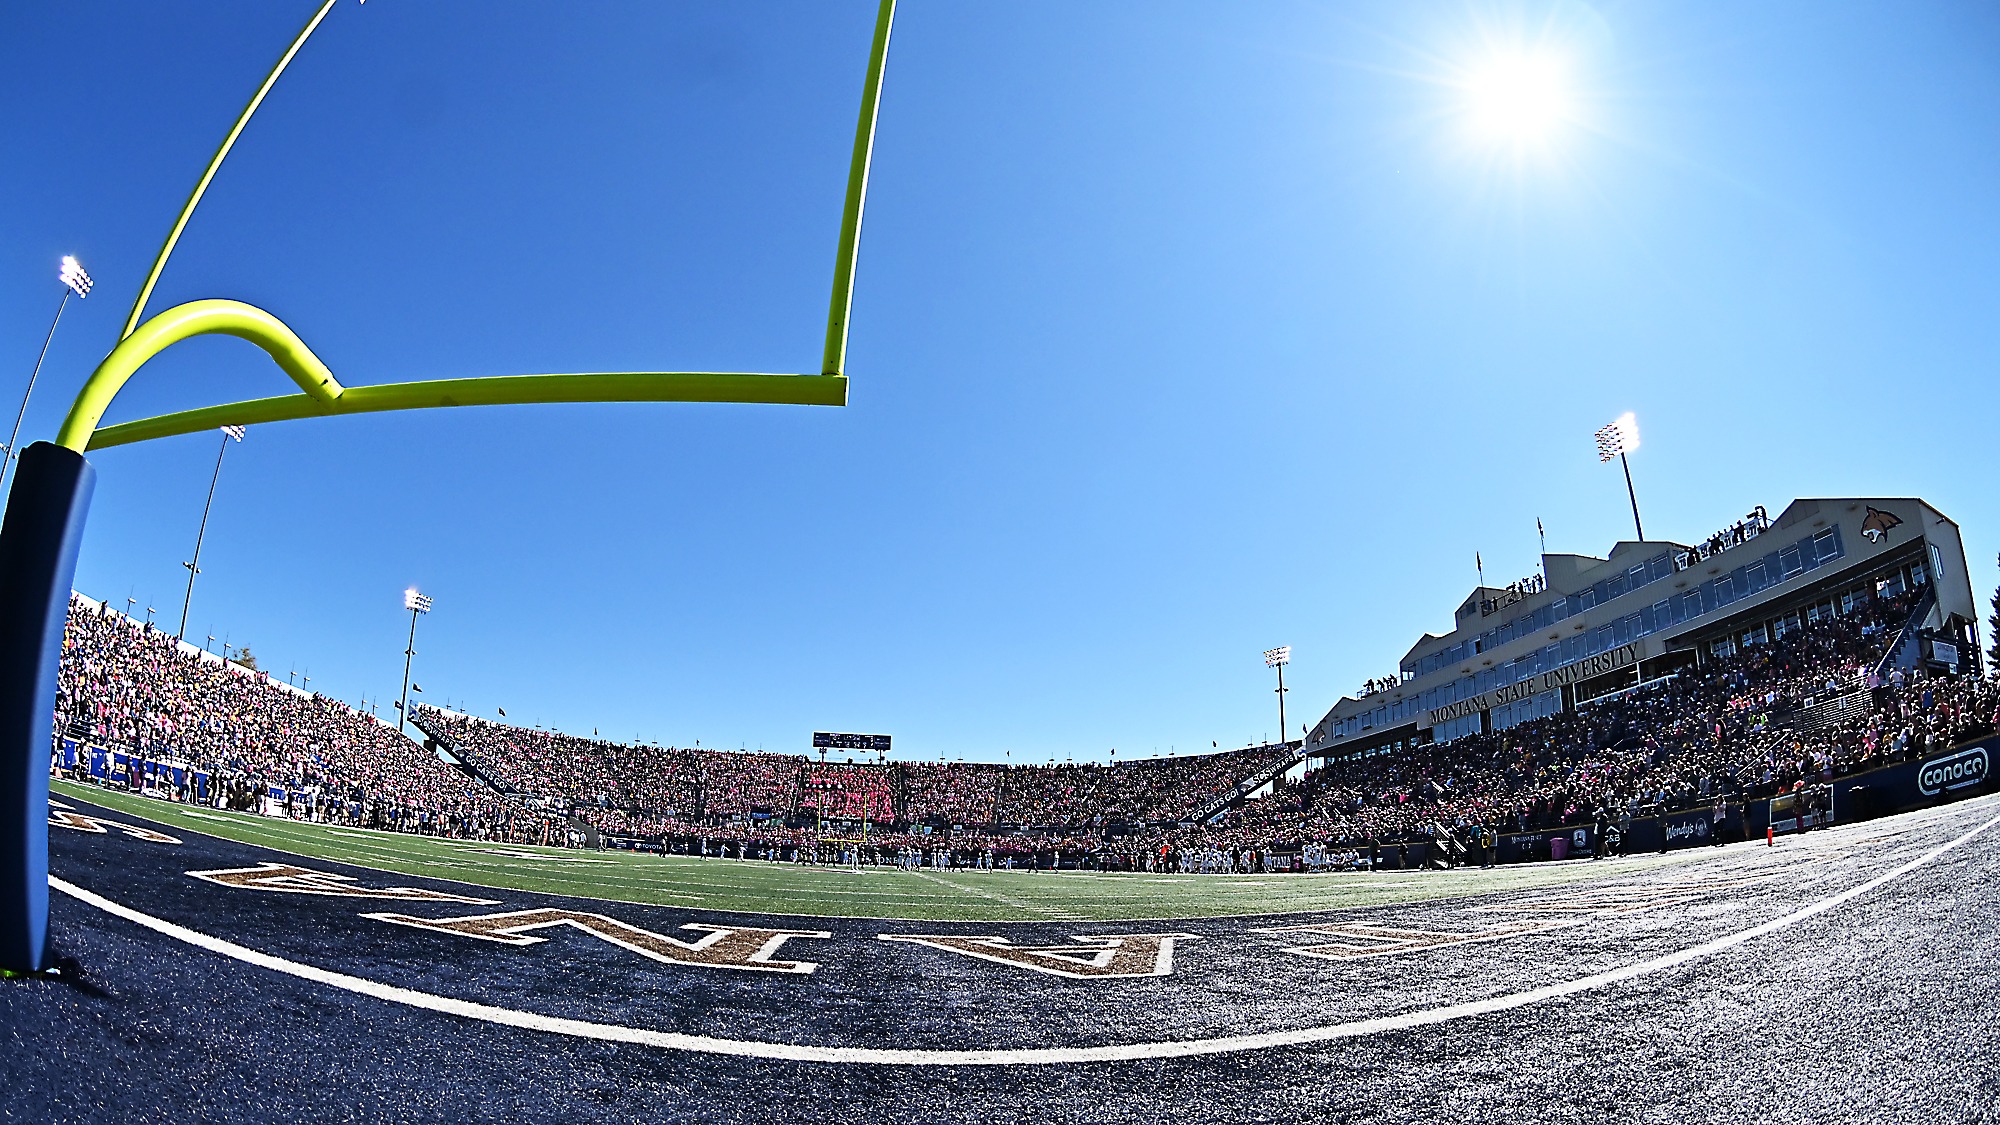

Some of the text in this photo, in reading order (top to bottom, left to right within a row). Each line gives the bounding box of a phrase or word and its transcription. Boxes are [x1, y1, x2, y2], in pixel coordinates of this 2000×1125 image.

[1430, 642, 1638, 724] MONTANA STATE UNIVERSITY
[465, 755, 507, 792] GO CATS GO!
[1191, 788, 1239, 821] GO CATS GO!
[1666, 821, 1695, 841] Wendy's
